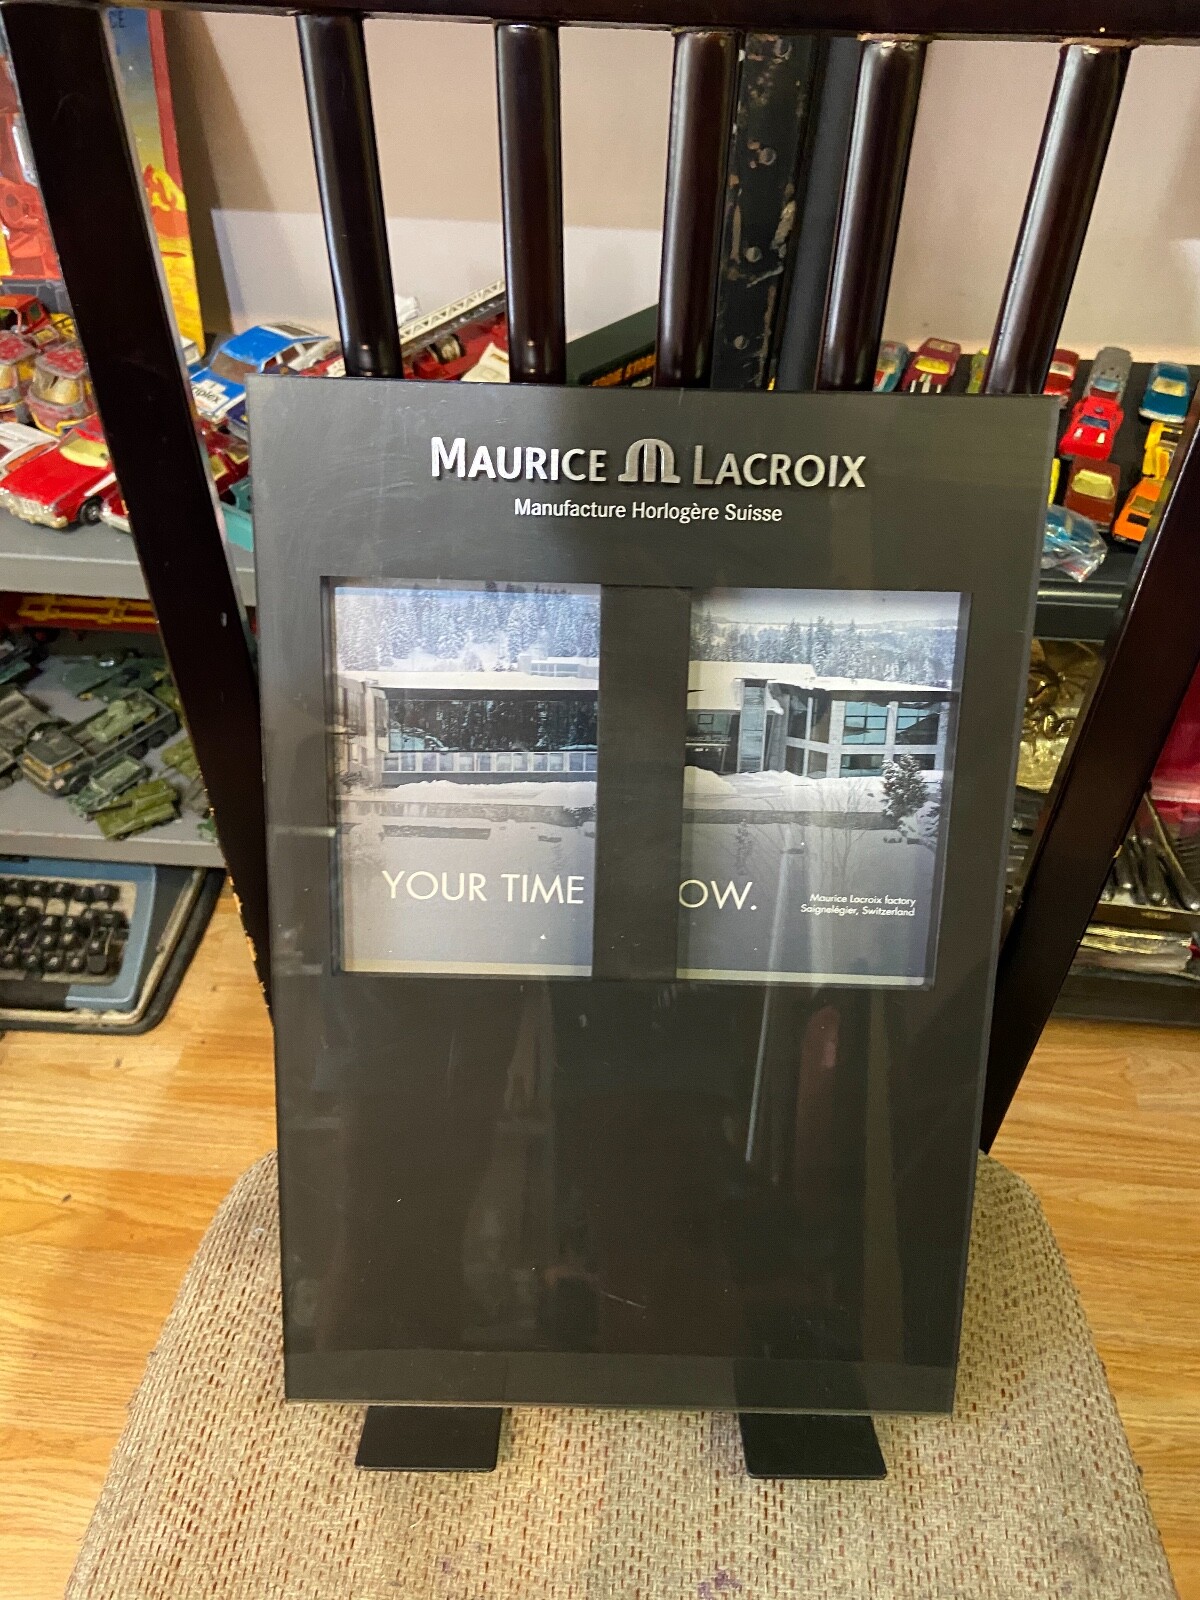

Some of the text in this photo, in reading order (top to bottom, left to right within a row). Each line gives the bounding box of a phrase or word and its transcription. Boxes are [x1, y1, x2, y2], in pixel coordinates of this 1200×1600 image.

[431, 436, 607, 482] MAURICE
[693, 444, 866, 488] LACROIX
[514, 498, 783, 524] Manufacture Horlogère Suisse
[381, 870, 488, 901] YOUR
[500, 873, 585, 904] TIME
[800, 903, 916, 917] Saignelégier, Switzerland
[809, 893, 917, 908] Maurice Lacroix factory
